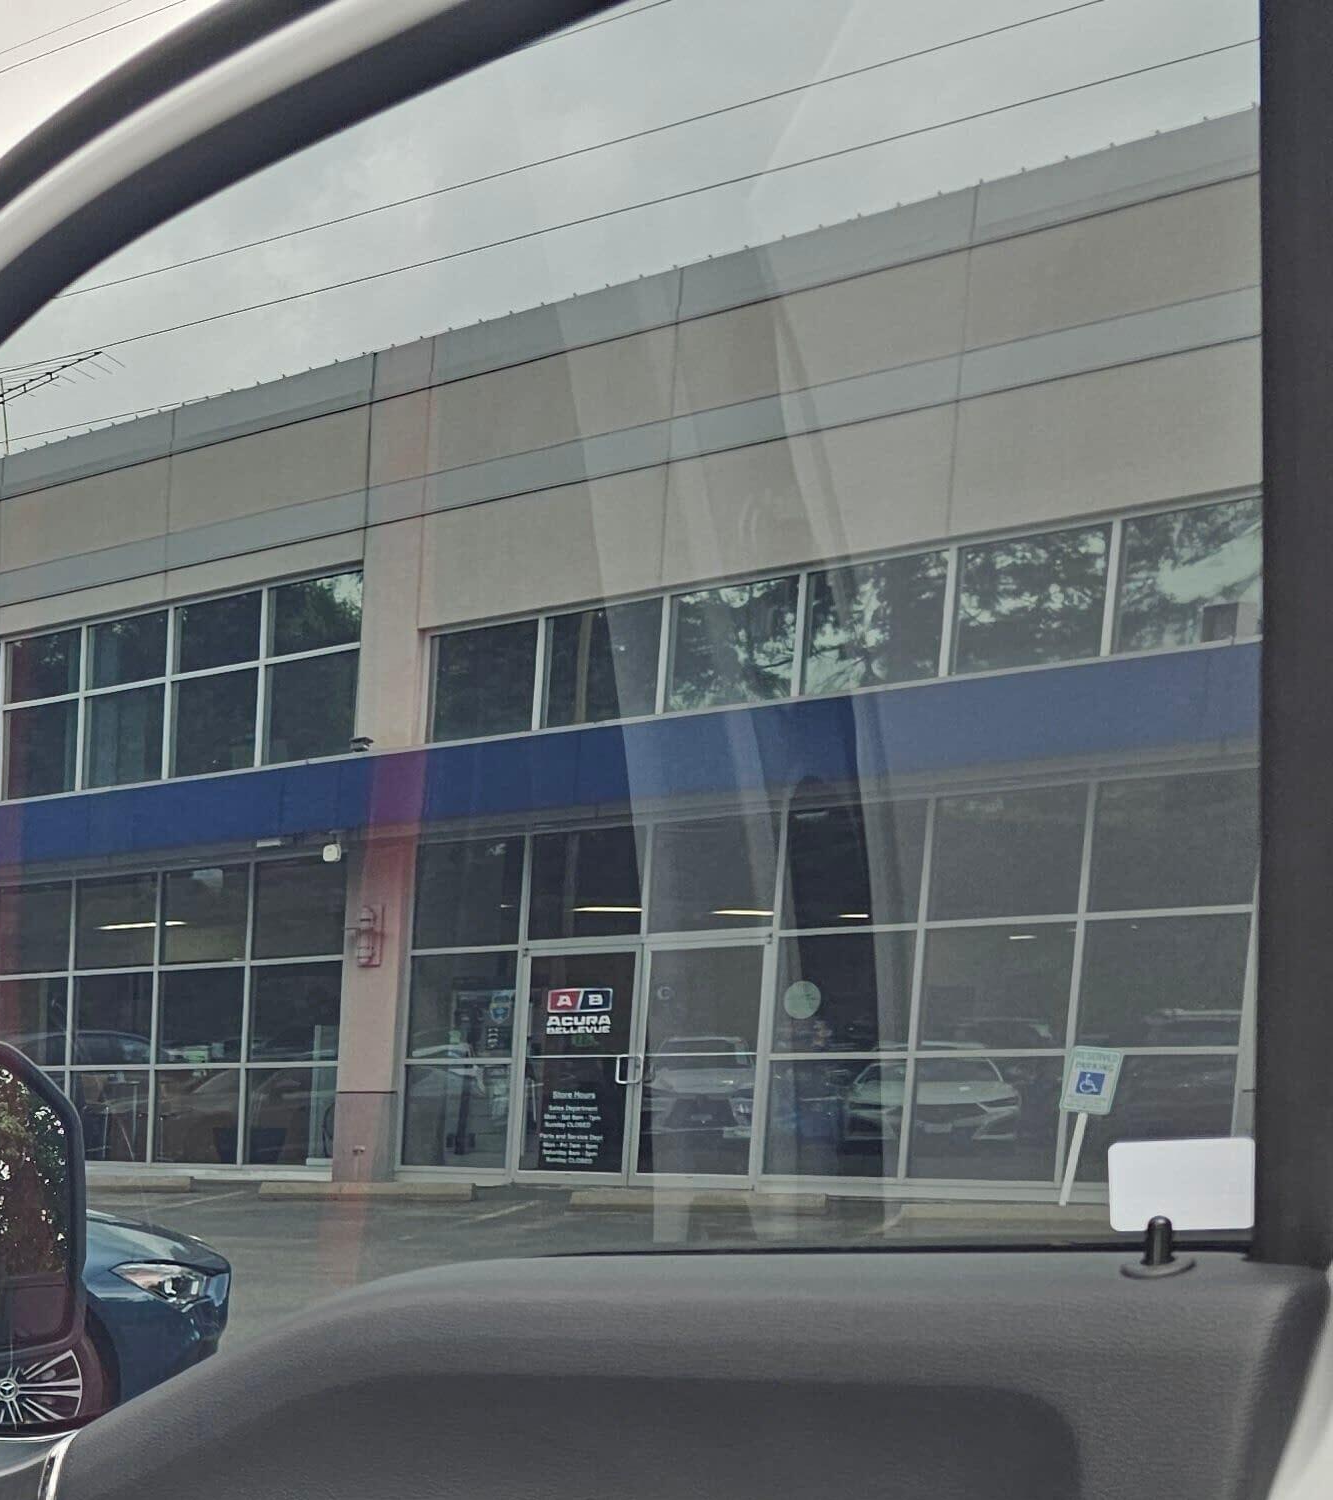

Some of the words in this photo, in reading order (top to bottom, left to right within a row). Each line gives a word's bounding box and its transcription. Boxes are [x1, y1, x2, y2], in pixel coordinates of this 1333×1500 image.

[556, 994, 573, 1008] A
[588, 994, 604, 1006] B
[546, 1015, 612, 1027] ACURA
[546, 1025, 611, 1035] BELLEVUE
